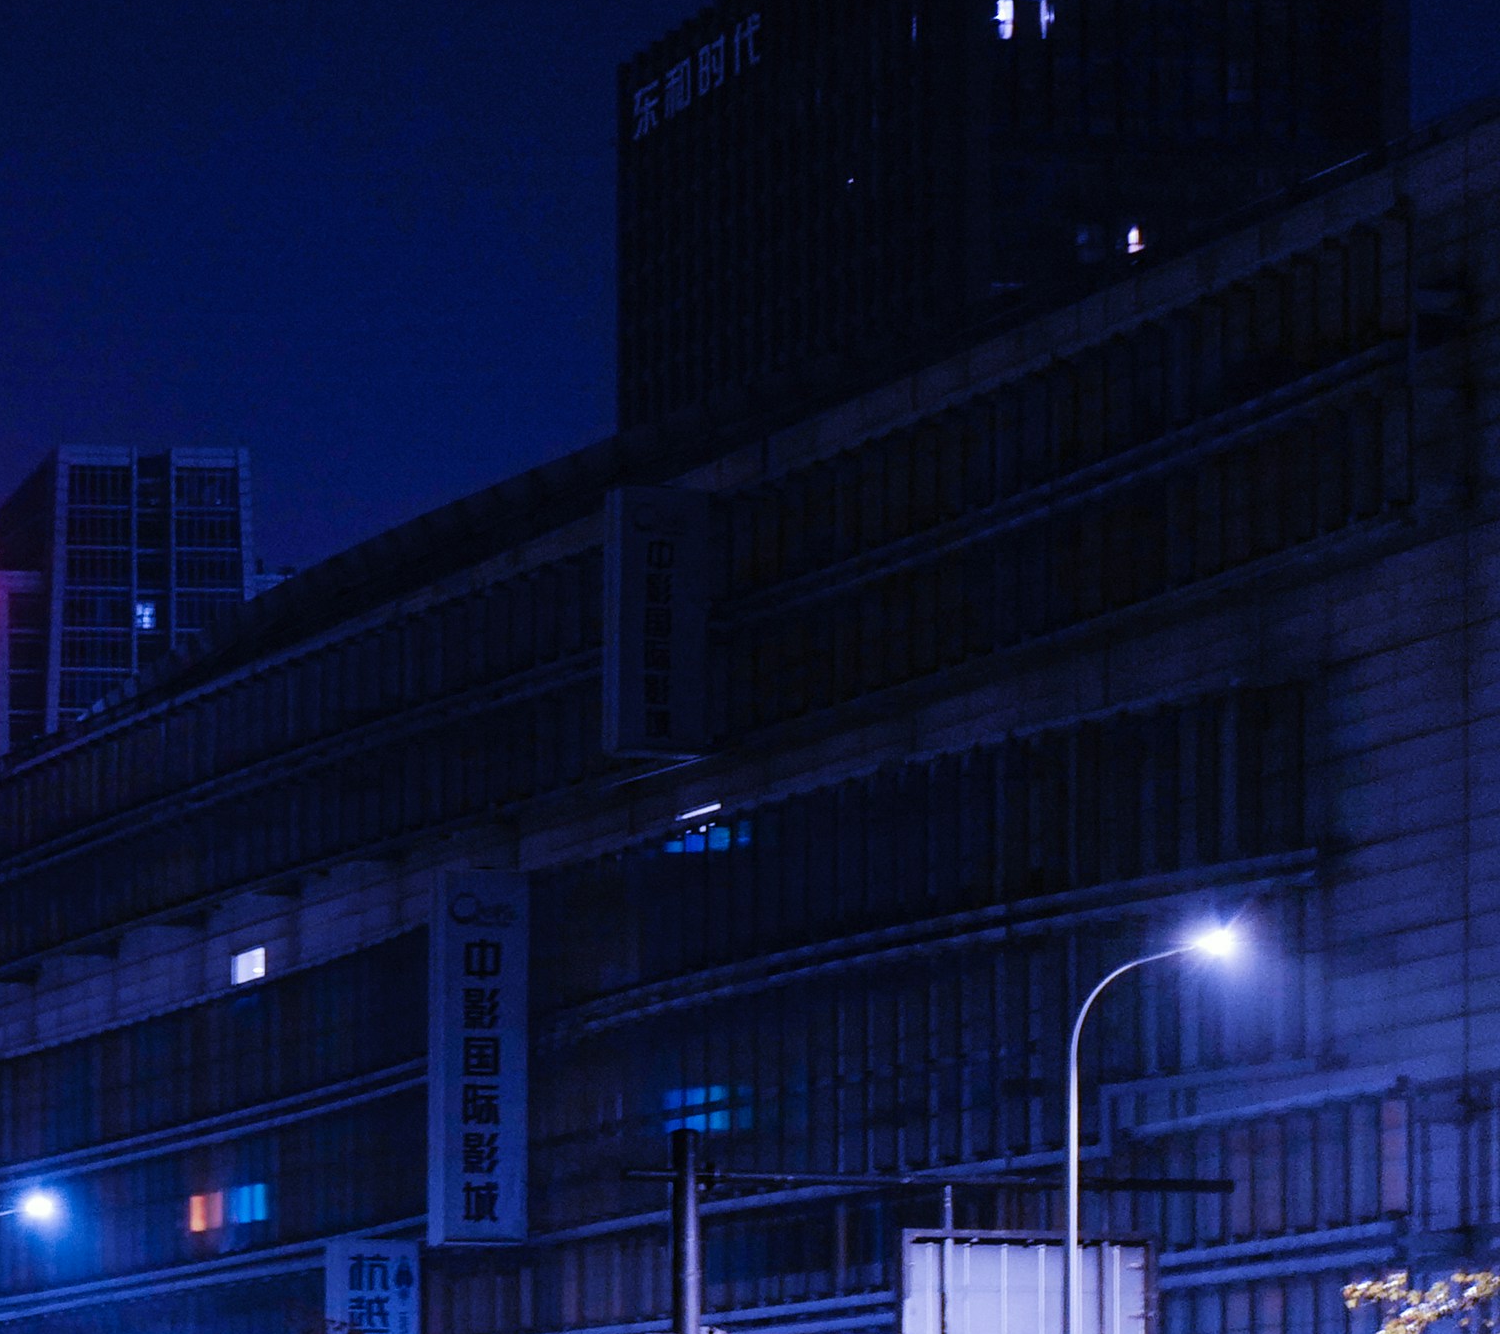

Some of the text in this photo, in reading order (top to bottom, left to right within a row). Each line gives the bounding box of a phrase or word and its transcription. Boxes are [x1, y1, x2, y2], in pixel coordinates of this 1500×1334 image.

[632, 12, 763, 141] 东和时代
[462, 938, 501, 1223] 中影国际影城
